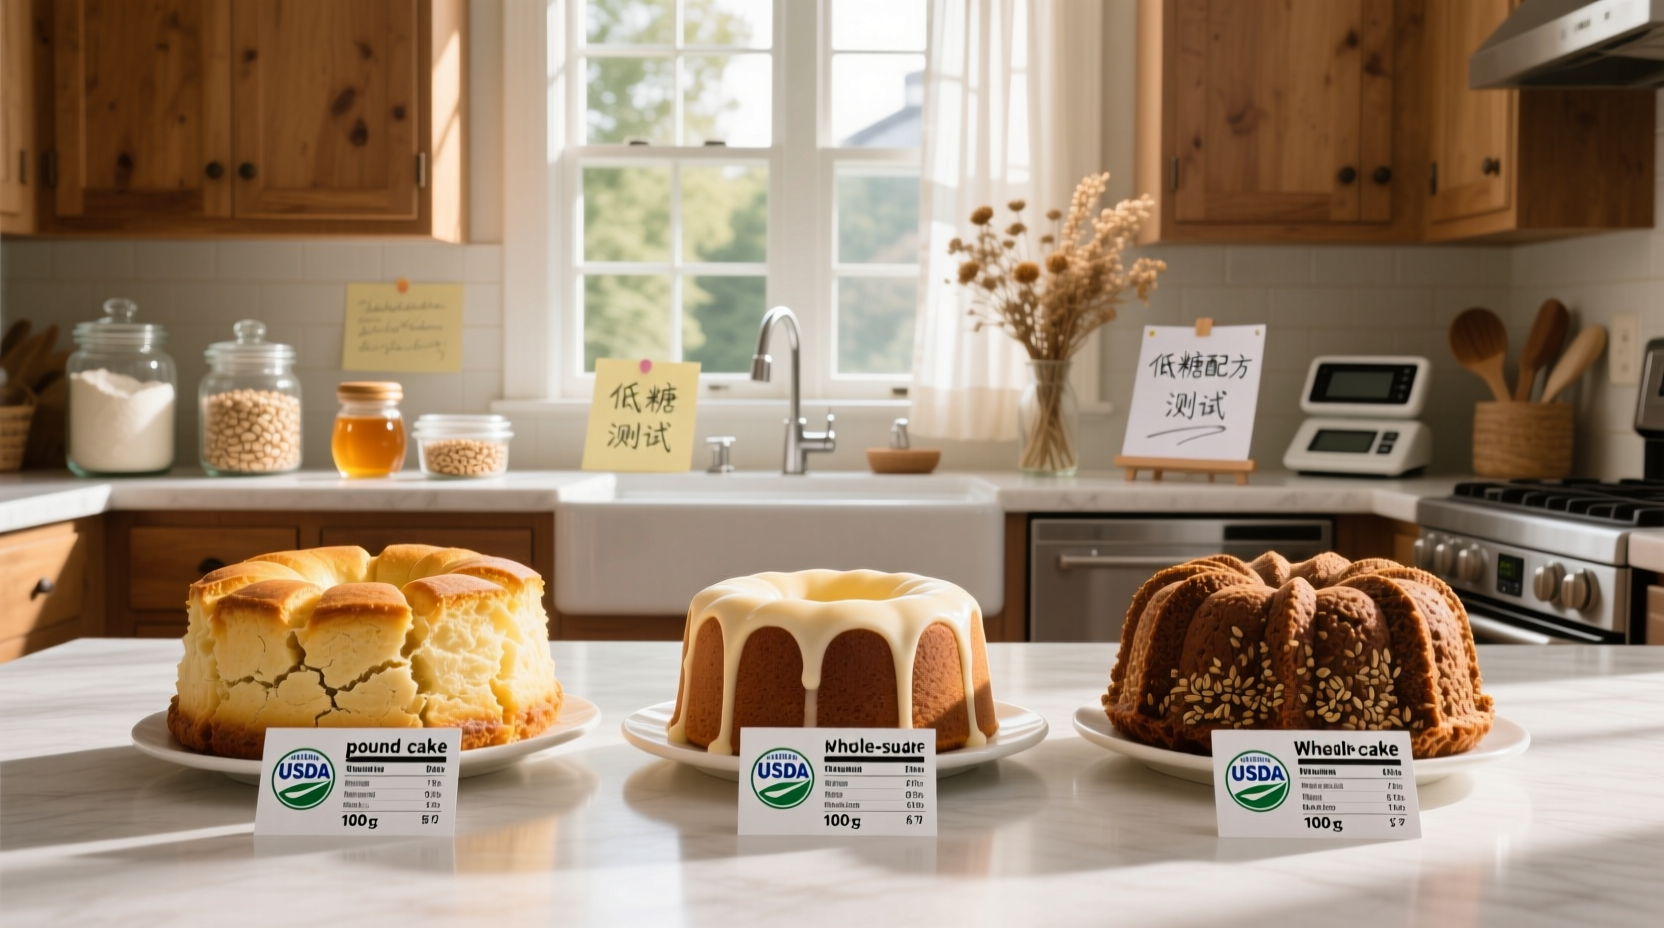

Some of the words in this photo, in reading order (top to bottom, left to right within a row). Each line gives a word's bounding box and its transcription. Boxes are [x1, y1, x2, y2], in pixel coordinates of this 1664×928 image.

[1149, 350, 1252, 380] 低糖配方
[609, 381, 678, 414] 低糖
[1165, 390, 1228, 421] 测试
[607, 421, 672, 453] 测试
[346, 738, 401, 758] pound
[407, 738, 448, 754] cake
[278, 762, 331, 780] USDA
[757, 762, 810, 779] USDA
[1231, 765, 1285, 782] USDA
